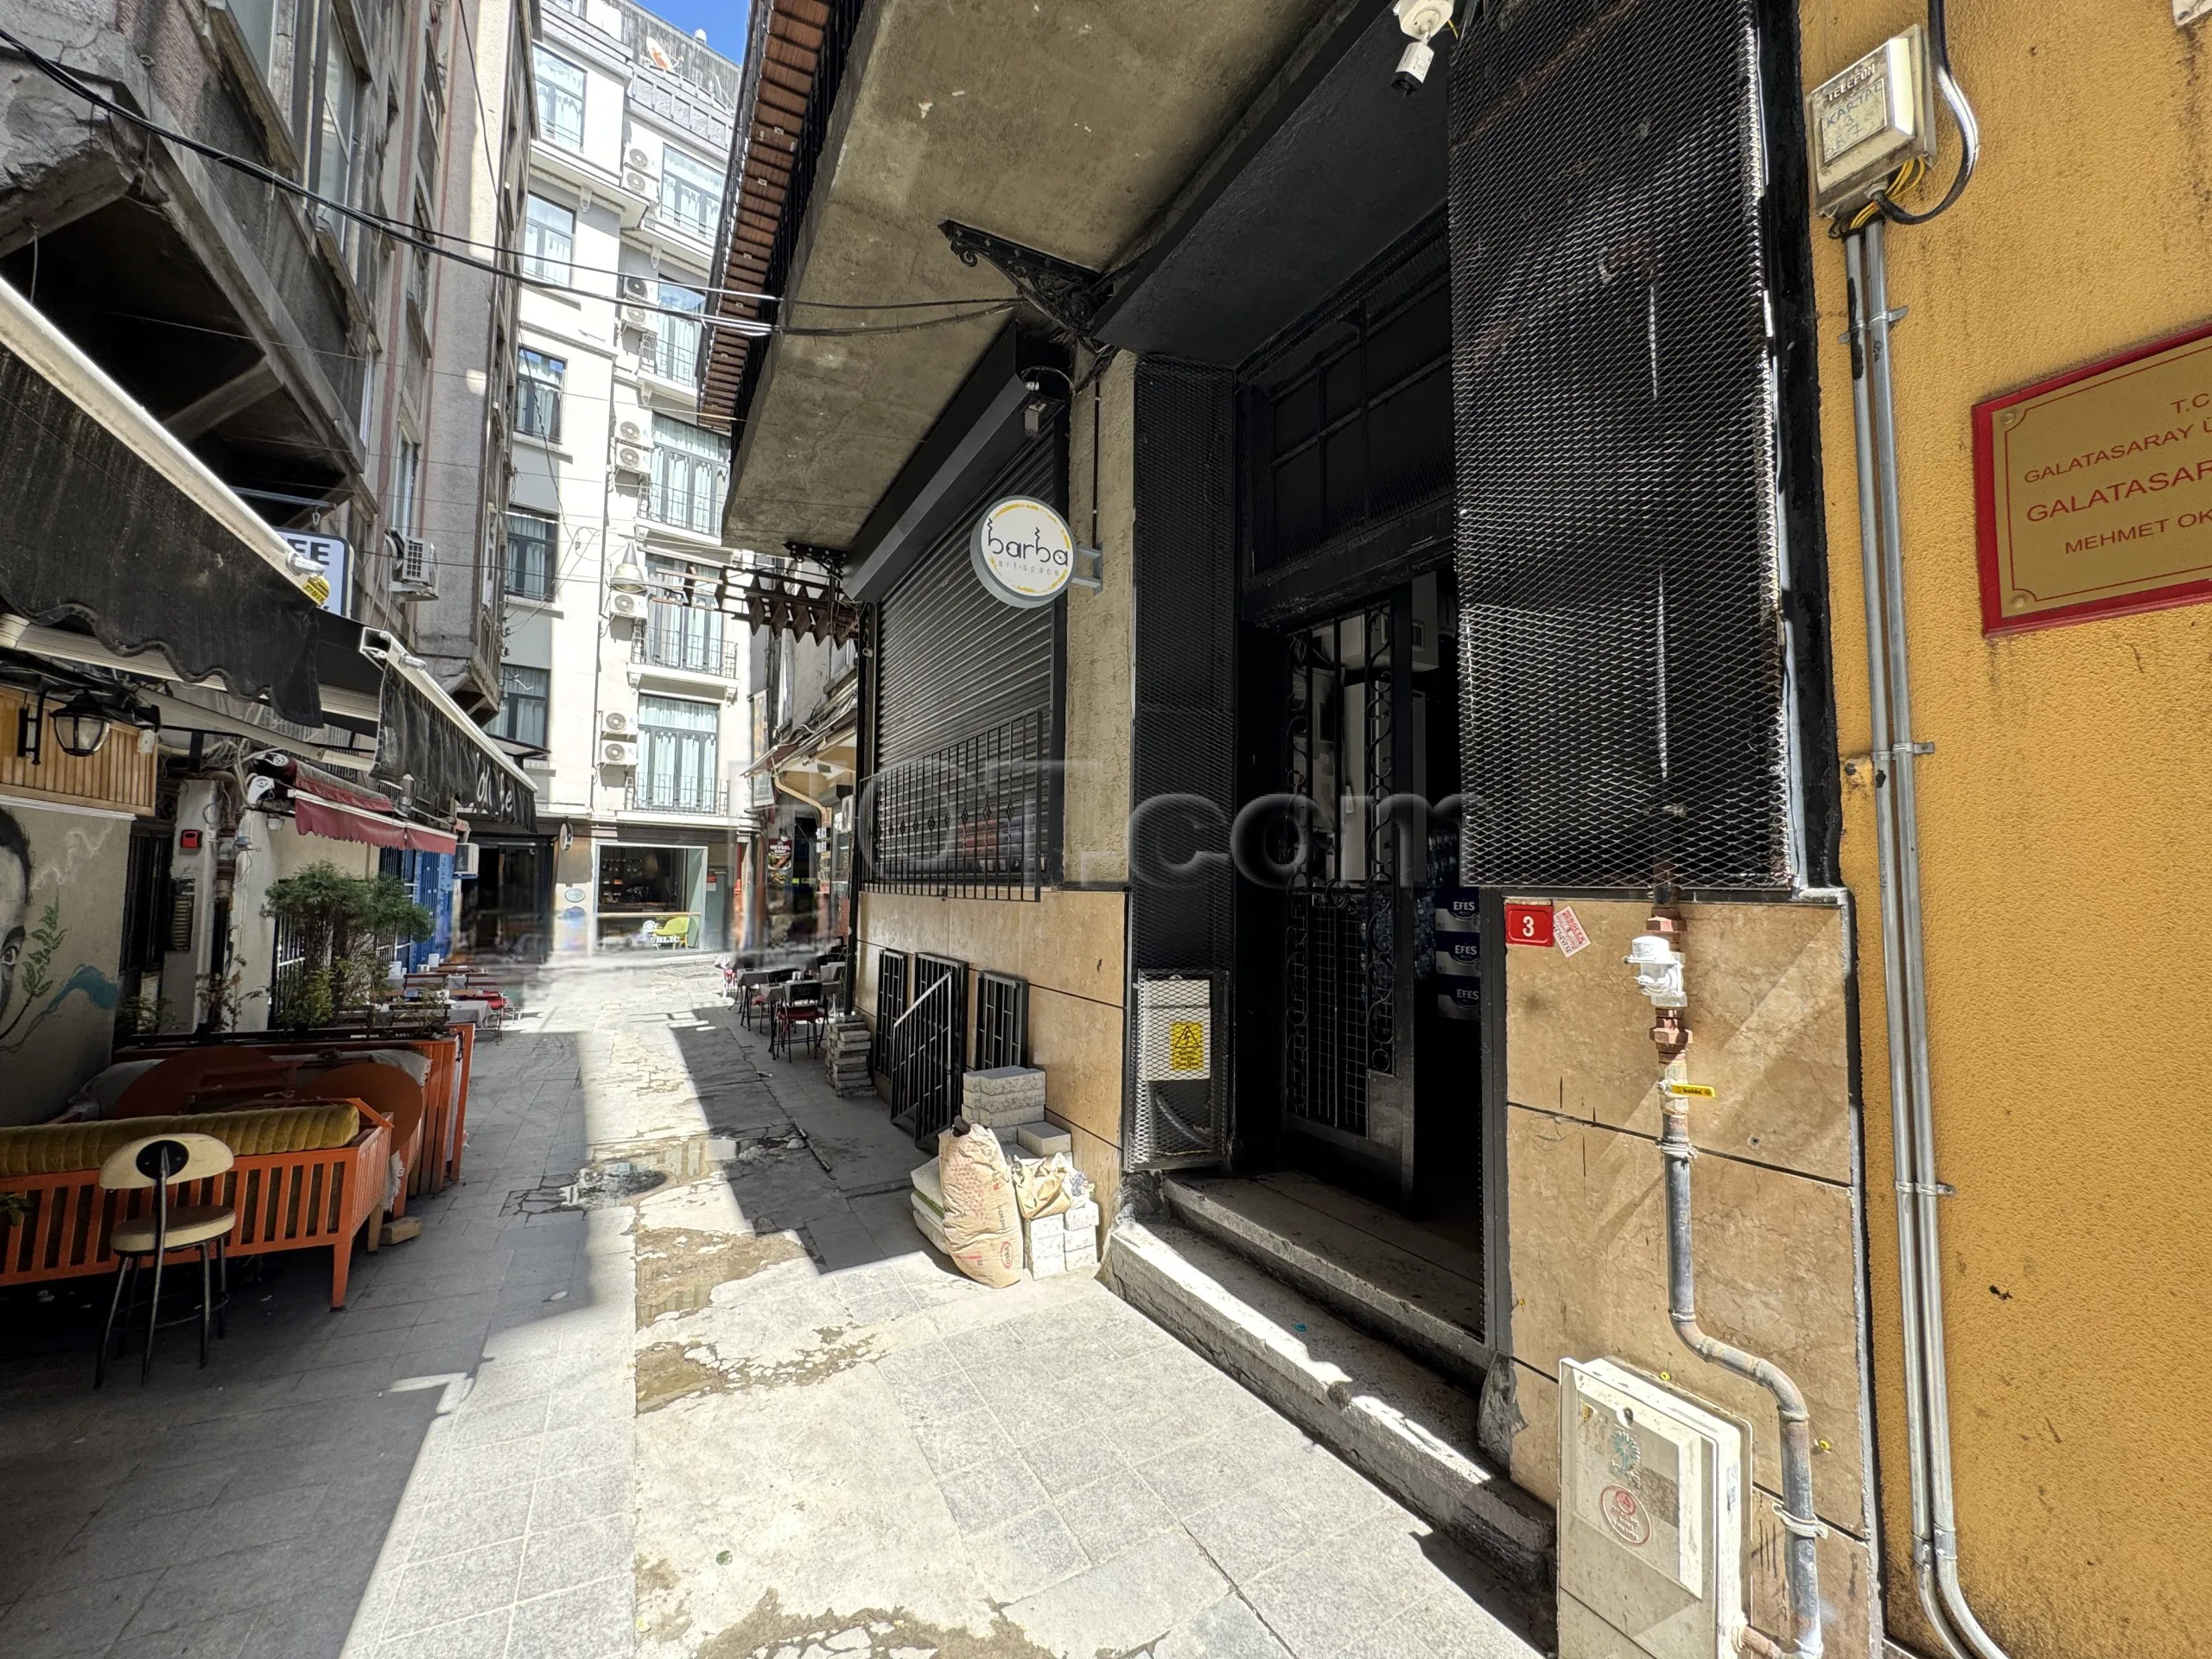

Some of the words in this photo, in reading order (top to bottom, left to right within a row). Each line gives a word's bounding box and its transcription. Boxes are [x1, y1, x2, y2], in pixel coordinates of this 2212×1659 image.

[1827, 63, 1875, 101] TELEFON
[1827, 81, 1883, 127] KARTAL
[2024, 423, 2194, 483] GALATASARAY
[987, 518, 1068, 567] barba
[2065, 518, 2170, 554] MEHMET
[1453, 901, 1475, 912] EFES
[1522, 916, 1535, 938] 3
[1455, 945, 1477, 956] EFES
[1457, 988, 1479, 1000] EFES
